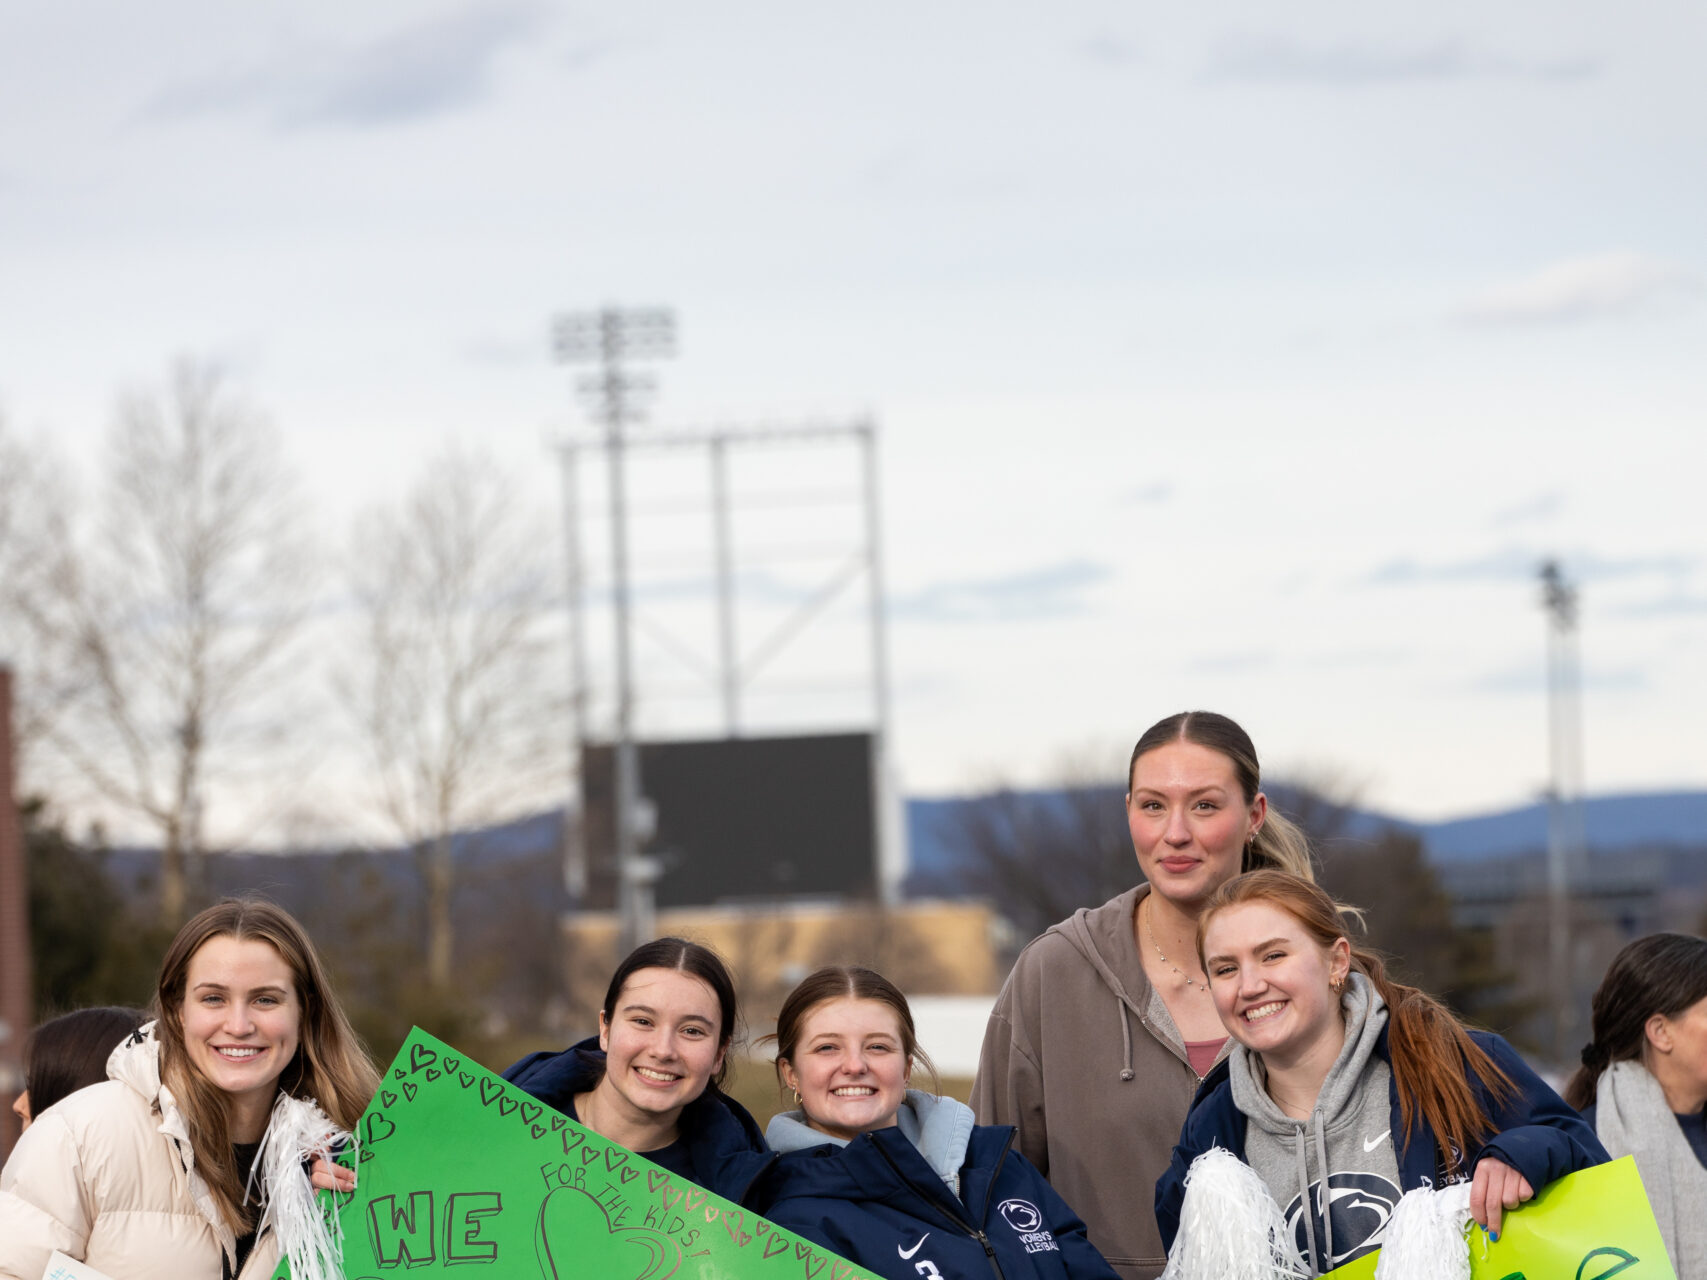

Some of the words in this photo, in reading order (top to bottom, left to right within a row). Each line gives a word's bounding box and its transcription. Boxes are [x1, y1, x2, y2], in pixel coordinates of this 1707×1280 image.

[366, 1190, 503, 1270] WE
[540, 1161, 587, 1191] FOR
[595, 1182, 633, 1227] THE
[643, 1204, 711, 1259] KIDS!
